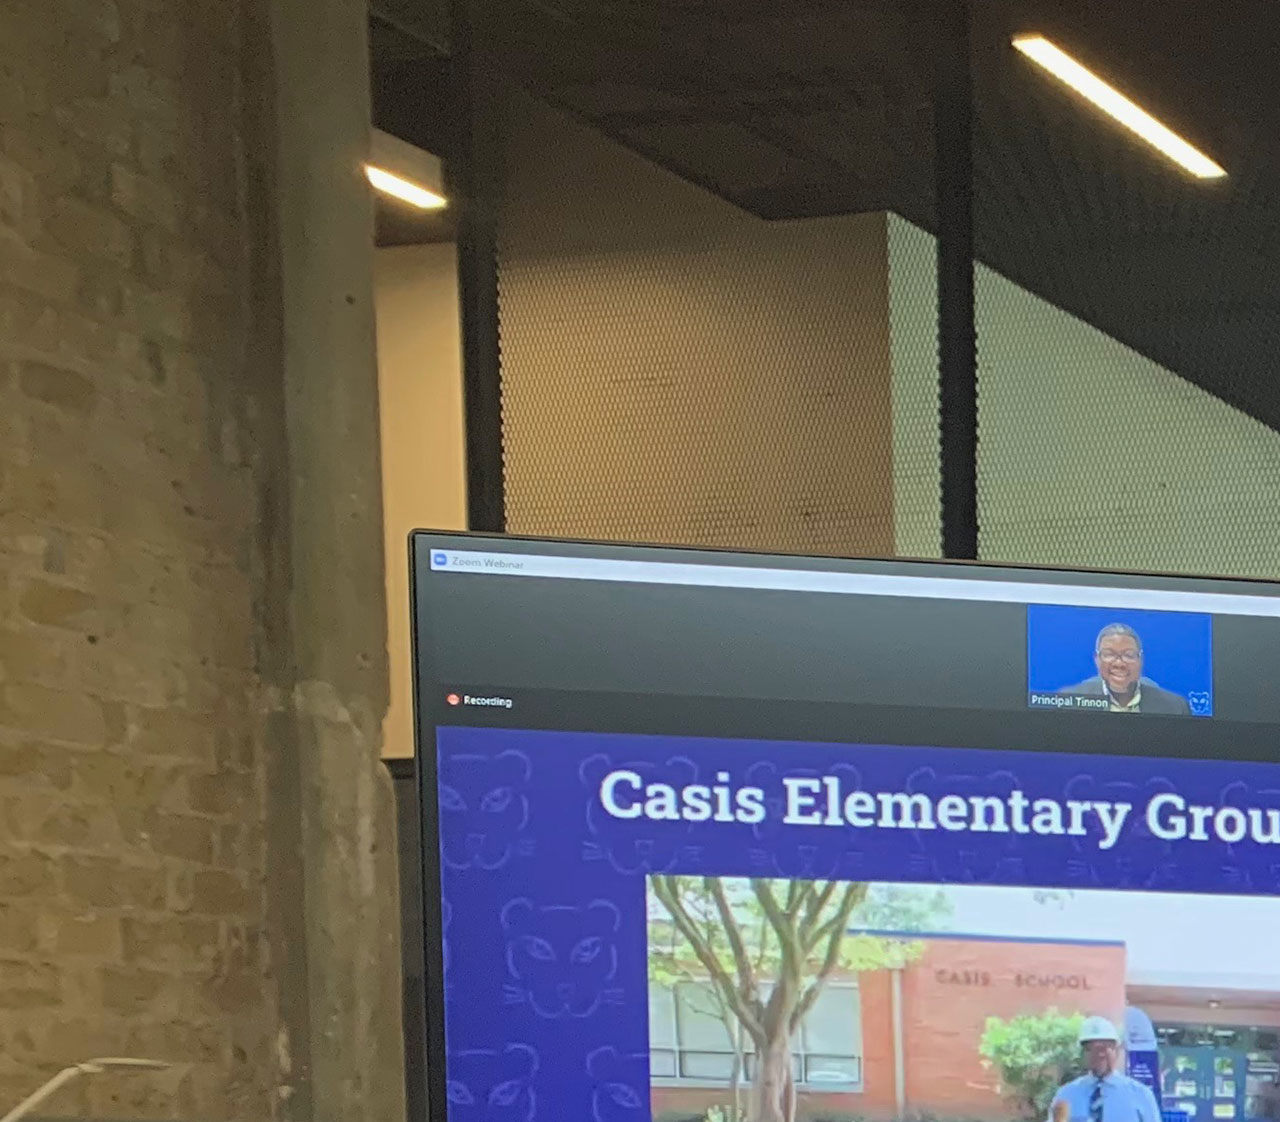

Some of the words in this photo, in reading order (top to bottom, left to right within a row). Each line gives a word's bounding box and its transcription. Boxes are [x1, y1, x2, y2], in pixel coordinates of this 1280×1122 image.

[452, 557, 481, 567] Zoom
[484, 558, 523, 569] Webinar
[464, 695, 512, 708] Recording
[1032, 695, 1072, 708] Principal
[1075, 697, 1108, 708] Tinnon
[600, 770, 766, 826] Casis
[783, 778, 1131, 850] Elementary
[936, 969, 991, 986] CASIS
[1015, 974, 1092, 990] SCHOOL
